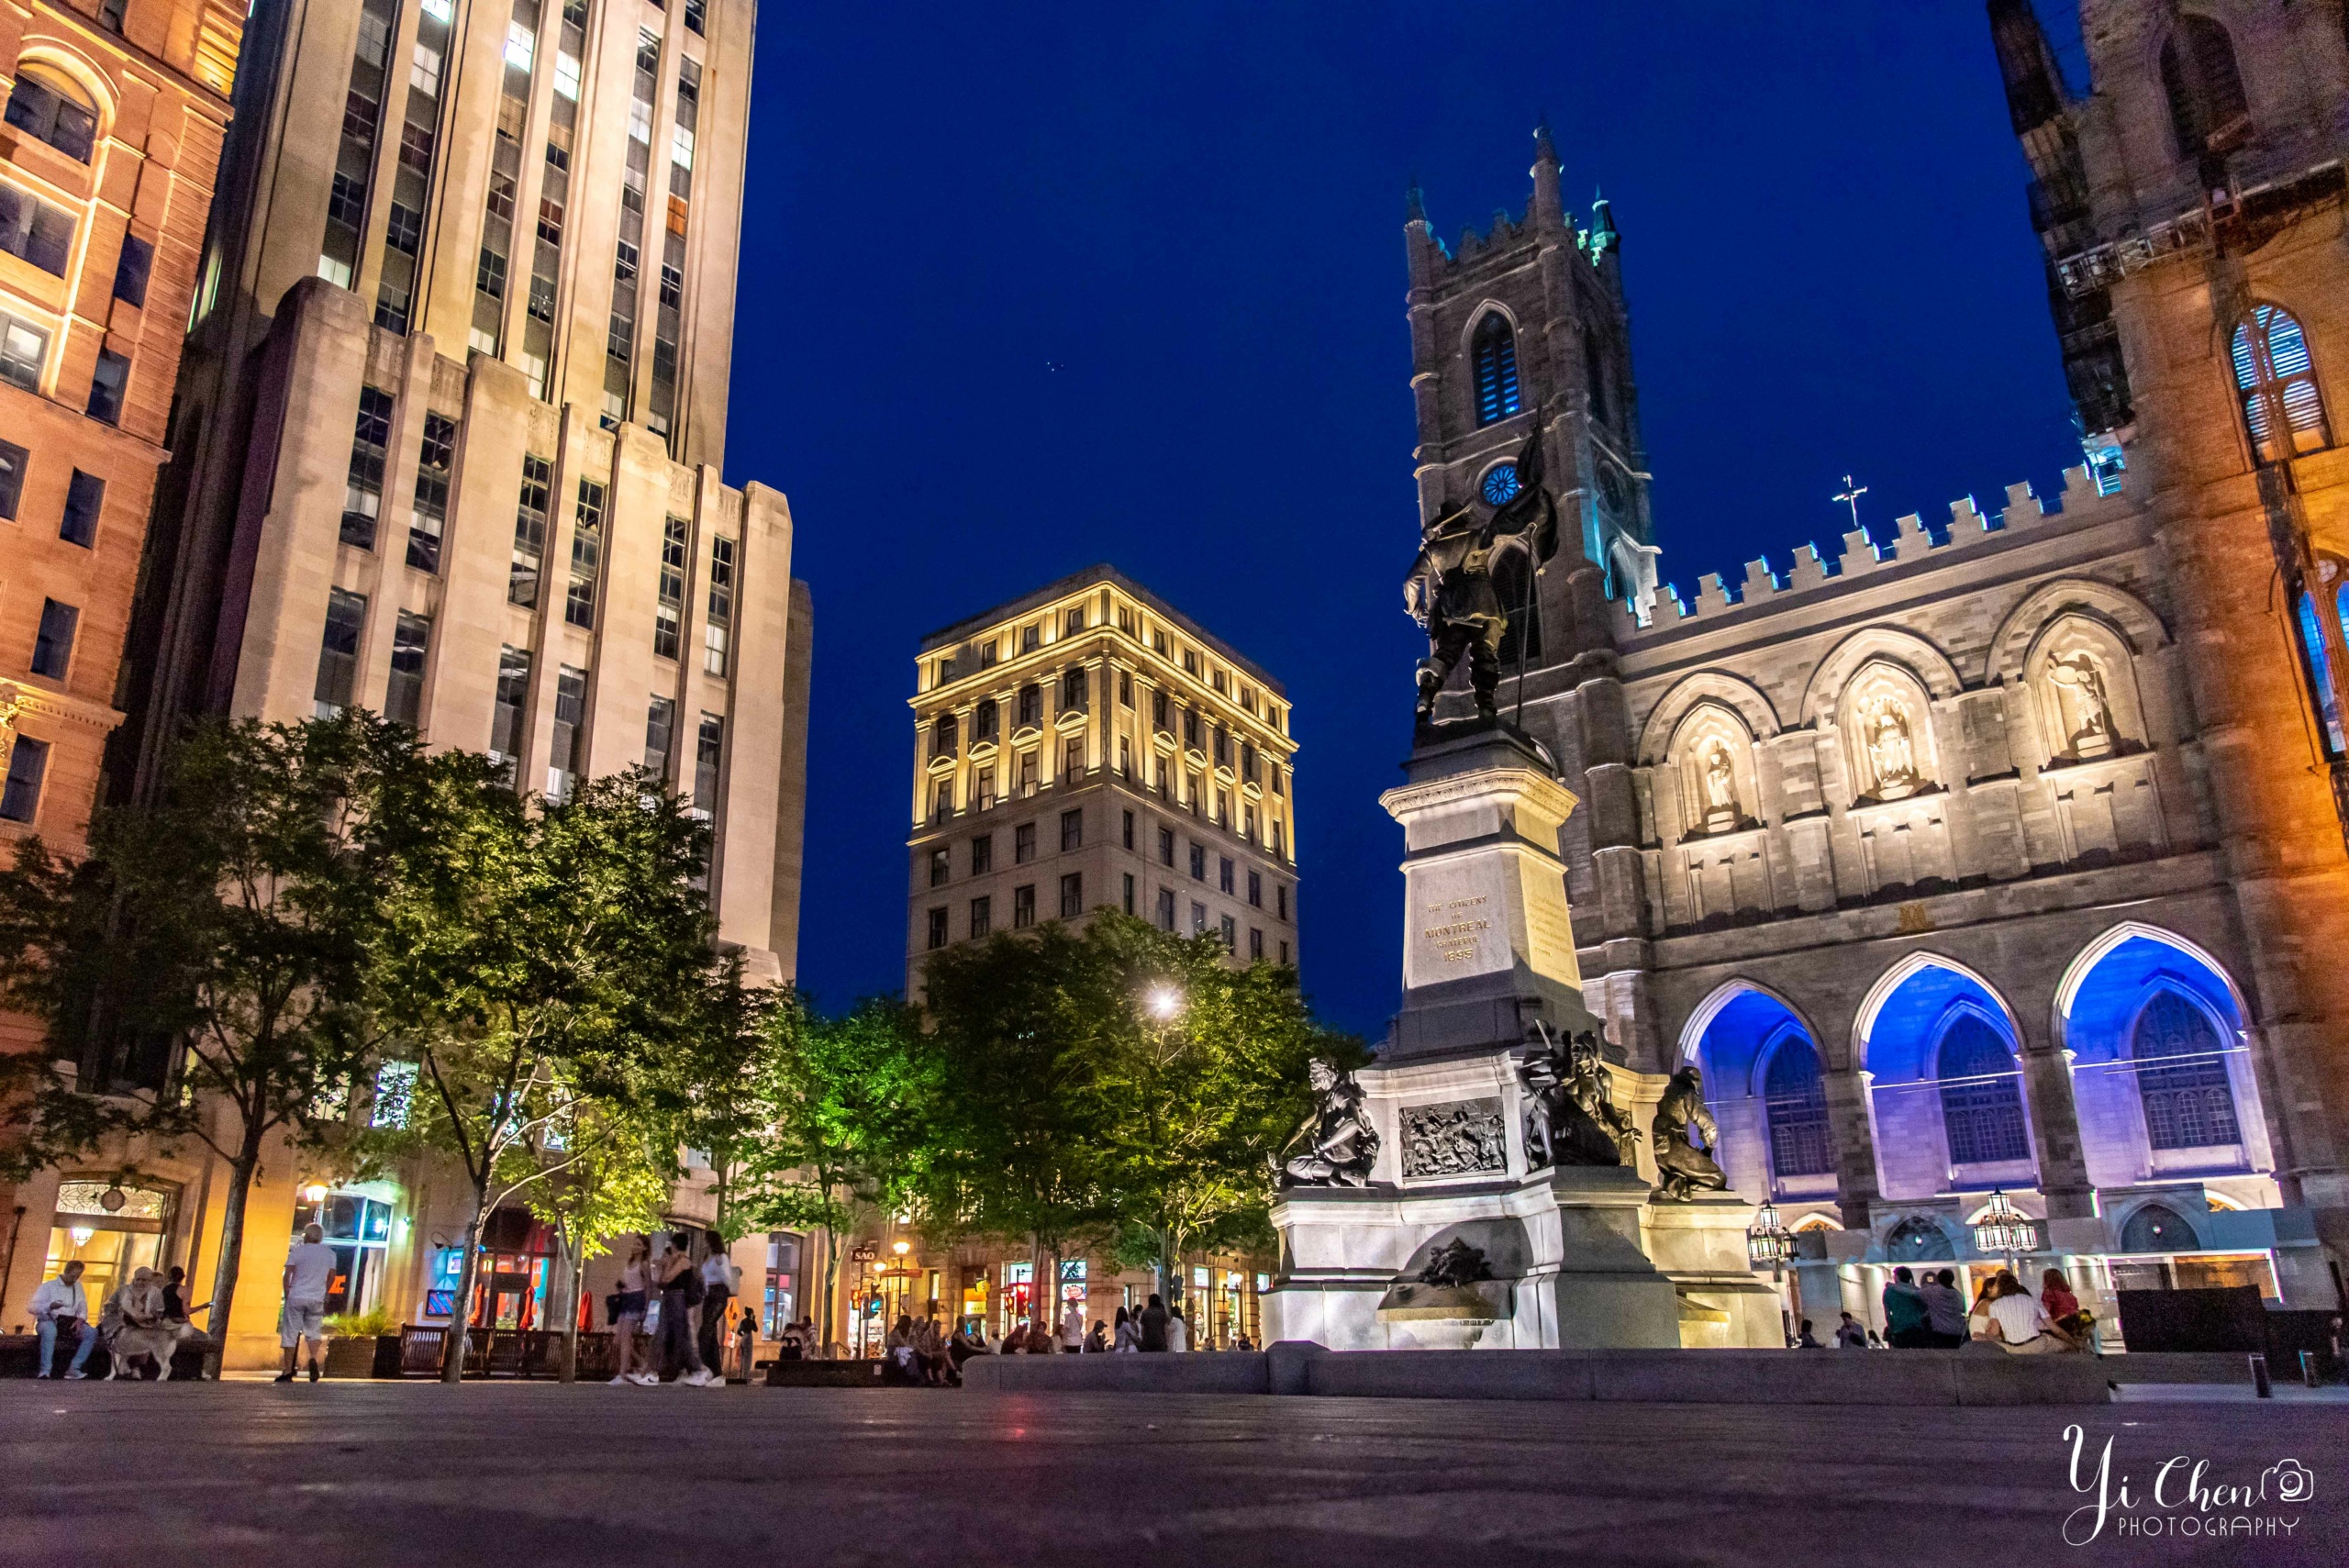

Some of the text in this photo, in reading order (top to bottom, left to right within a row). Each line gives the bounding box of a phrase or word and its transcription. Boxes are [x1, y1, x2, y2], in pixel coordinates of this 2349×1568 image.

[1427, 895, 1487, 913] THE CITIZENS
[1425, 918, 1491, 939] MONTREAL
[1436, 934, 1480, 949] GRATEFUL
